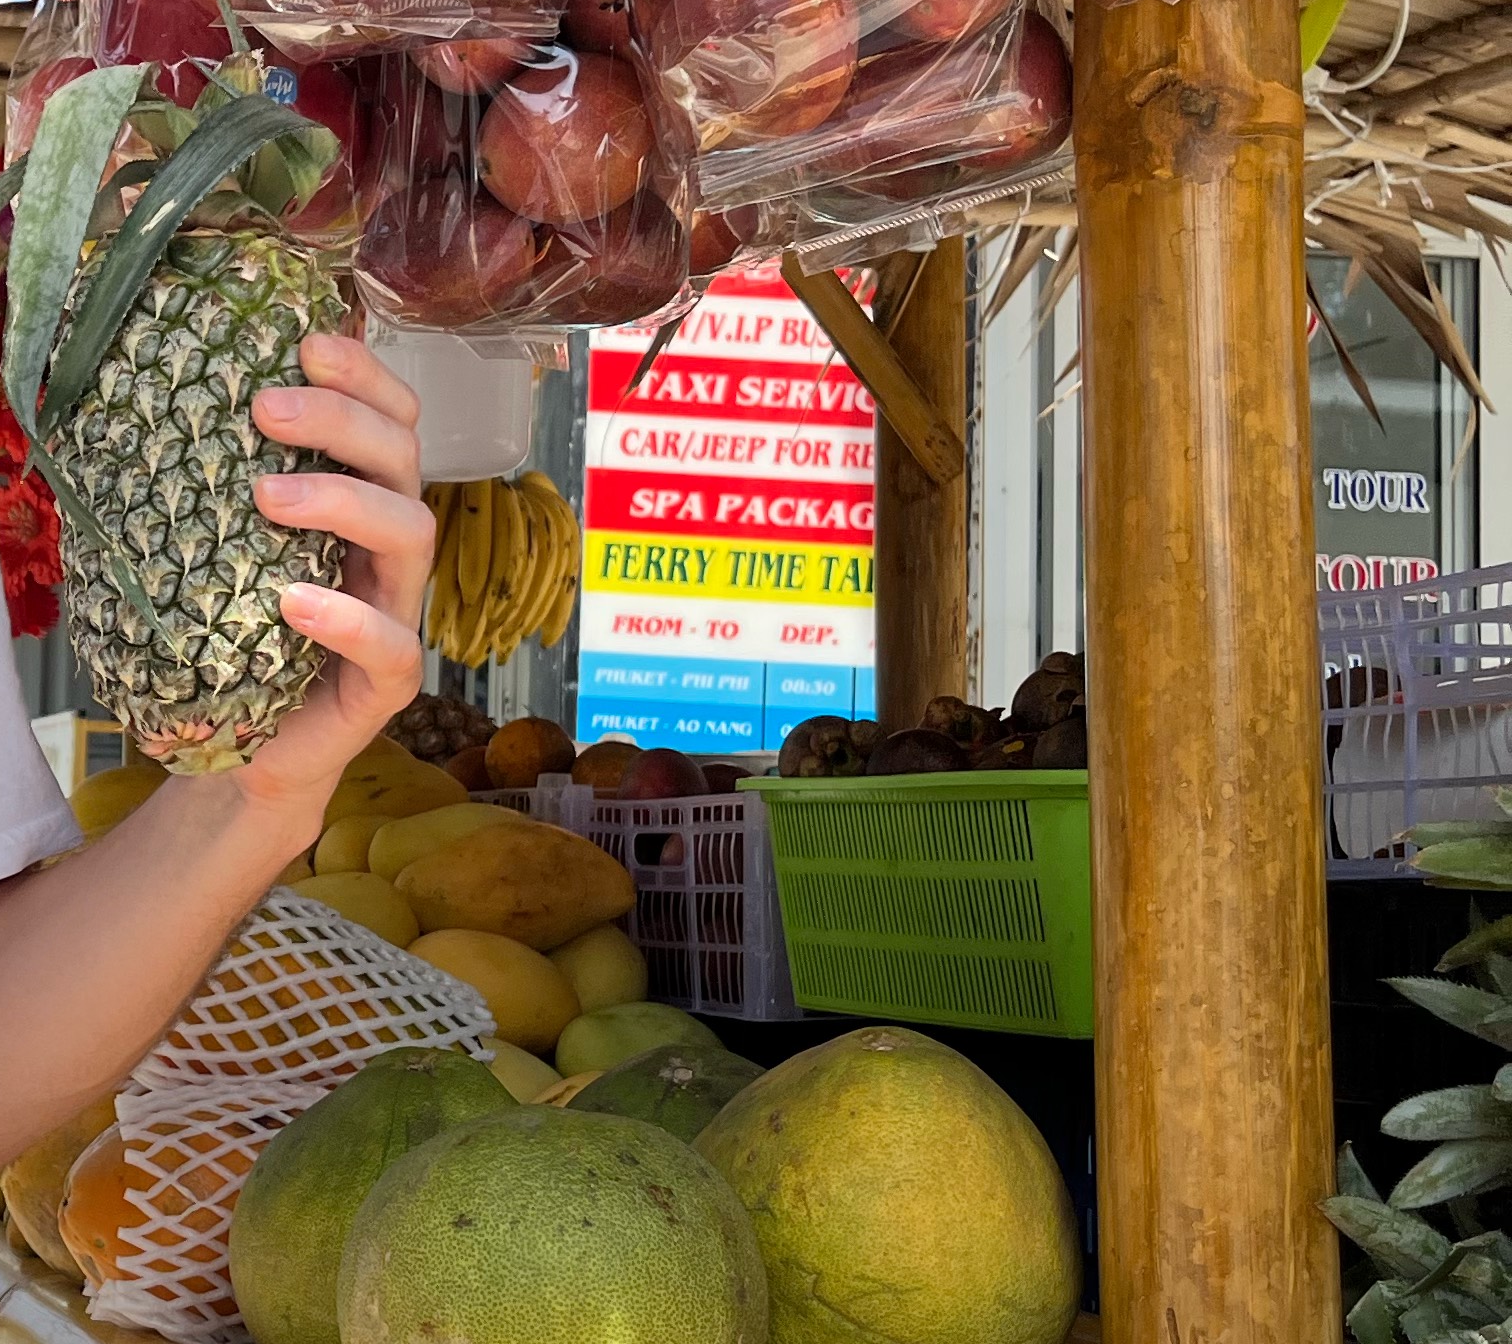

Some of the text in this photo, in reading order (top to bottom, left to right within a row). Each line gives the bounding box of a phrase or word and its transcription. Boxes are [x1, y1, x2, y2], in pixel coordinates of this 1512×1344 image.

[635, 370, 874, 414] TAXI SERVIC
[619, 428, 767, 464] CAR/JEEP
[773, 436, 831, 468] FOR
[1323, 467, 1430, 513] TOUR
[629, 488, 874, 531] SPA PACKAG
[600, 542, 717, 585] FERRY
[726, 548, 807, 591] TIME
[611, 613, 683, 638] FROM
[705, 618, 741, 641] TO
[779, 623, 841, 647] DEP.
[594, 666, 669, 688] PHUKET
[681, 672, 714, 690] PHI
[717, 674, 750, 692] PHI
[780, 677, 837, 697] 08:30
[591, 713, 660, 733] PHUKET
[674, 718, 701, 735] AO
[705, 721, 753, 737] NANG
